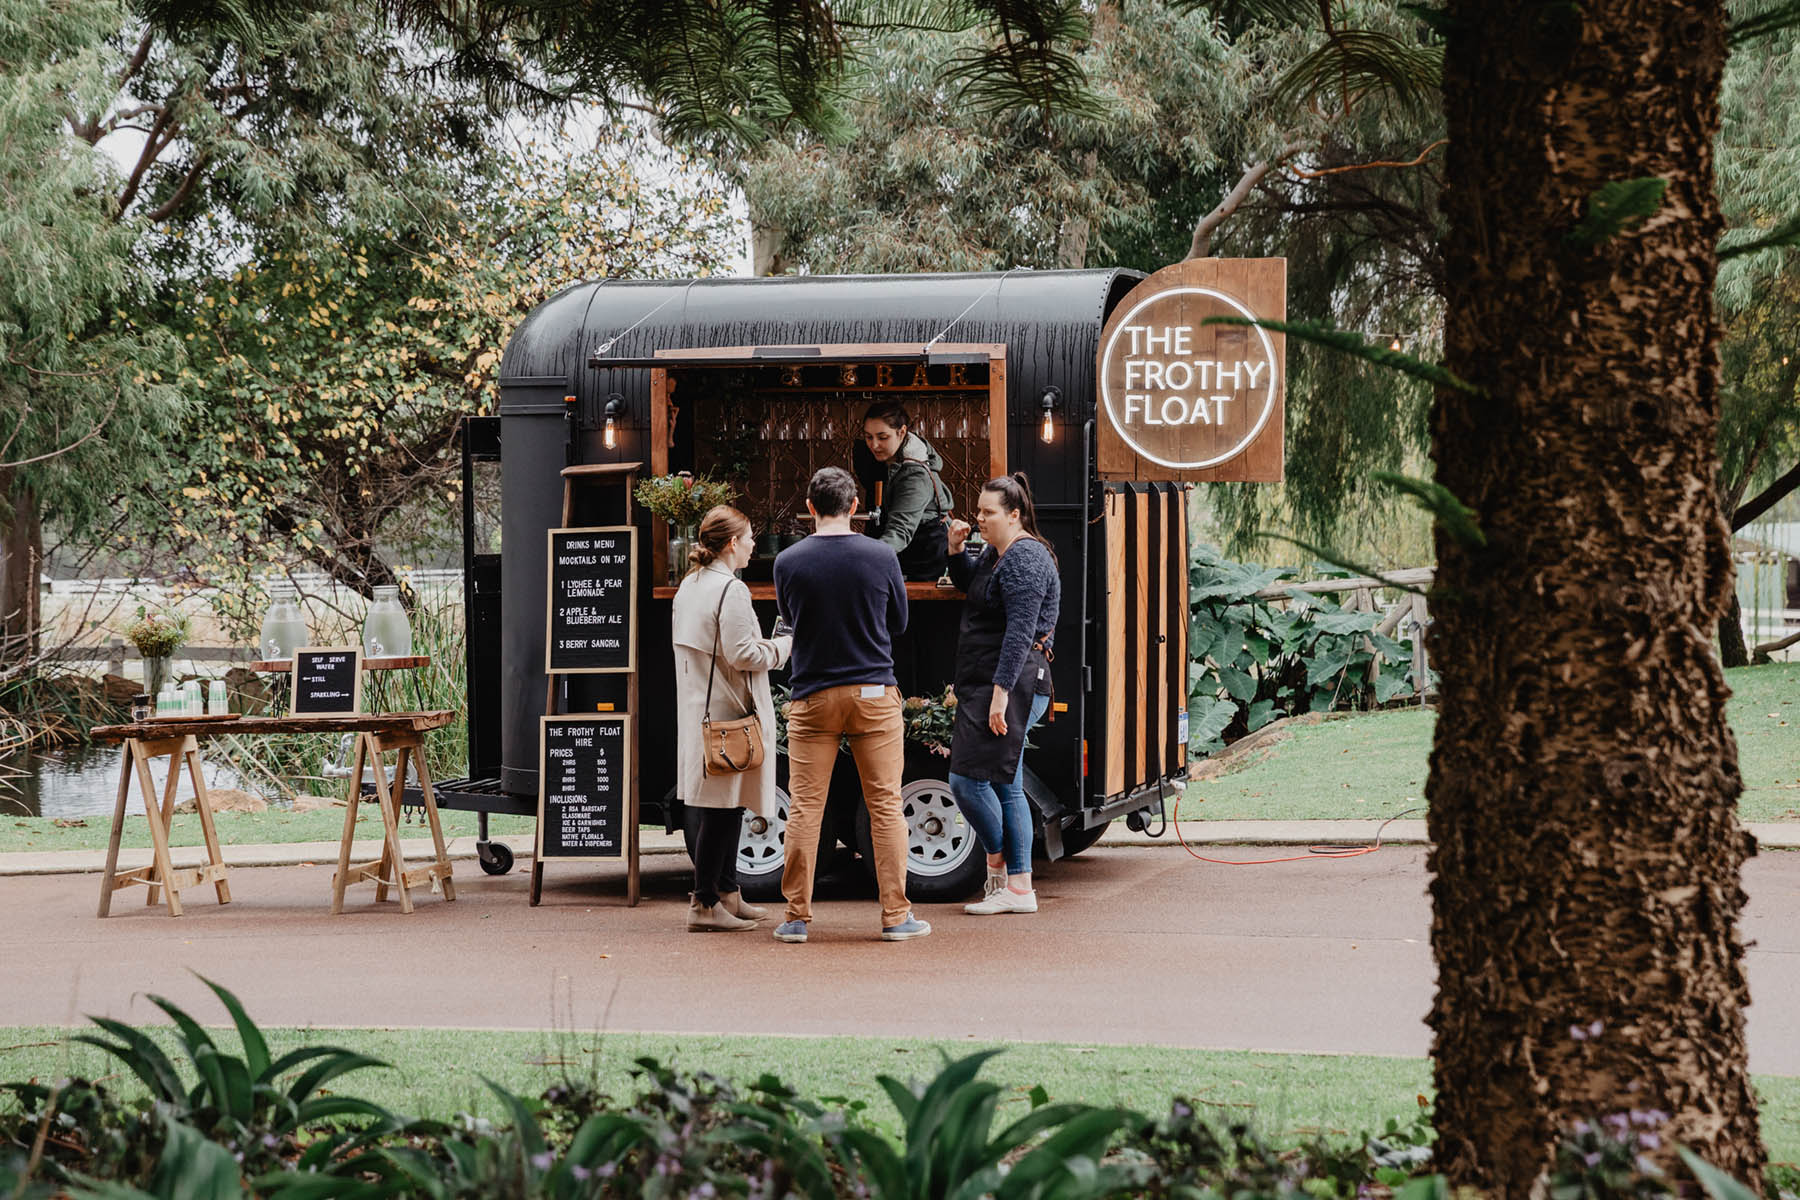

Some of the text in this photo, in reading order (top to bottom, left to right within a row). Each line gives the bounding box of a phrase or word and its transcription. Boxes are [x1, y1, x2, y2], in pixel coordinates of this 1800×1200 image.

[1124, 325, 1193, 355] THE
[876, 363, 968, 387] BAR
[1125, 360, 1265, 391] FROTHY
[1125, 394, 1231, 426] FLOAT
[566, 540, 615, 550] DRINKS MENU
[559, 555, 626, 565] MOCKTAILS ON TAP
[561, 579, 623, 589] 1 LYCHEE & PEAR
[567, 588, 605, 597] LEMONADE
[559, 606, 597, 617] 2 APPLE &
[566, 615, 622, 625] BLUEBERRY ALE
[559, 640, 565, 649] 3
[565, 640, 588, 649] BERRY
[549, 727, 621, 737] THE FROTHY FLOAT
[575, 738, 593, 747] HIRE
[549, 748, 605, 757] PRICES $
[549, 795, 588, 804] INCLUSIONS
